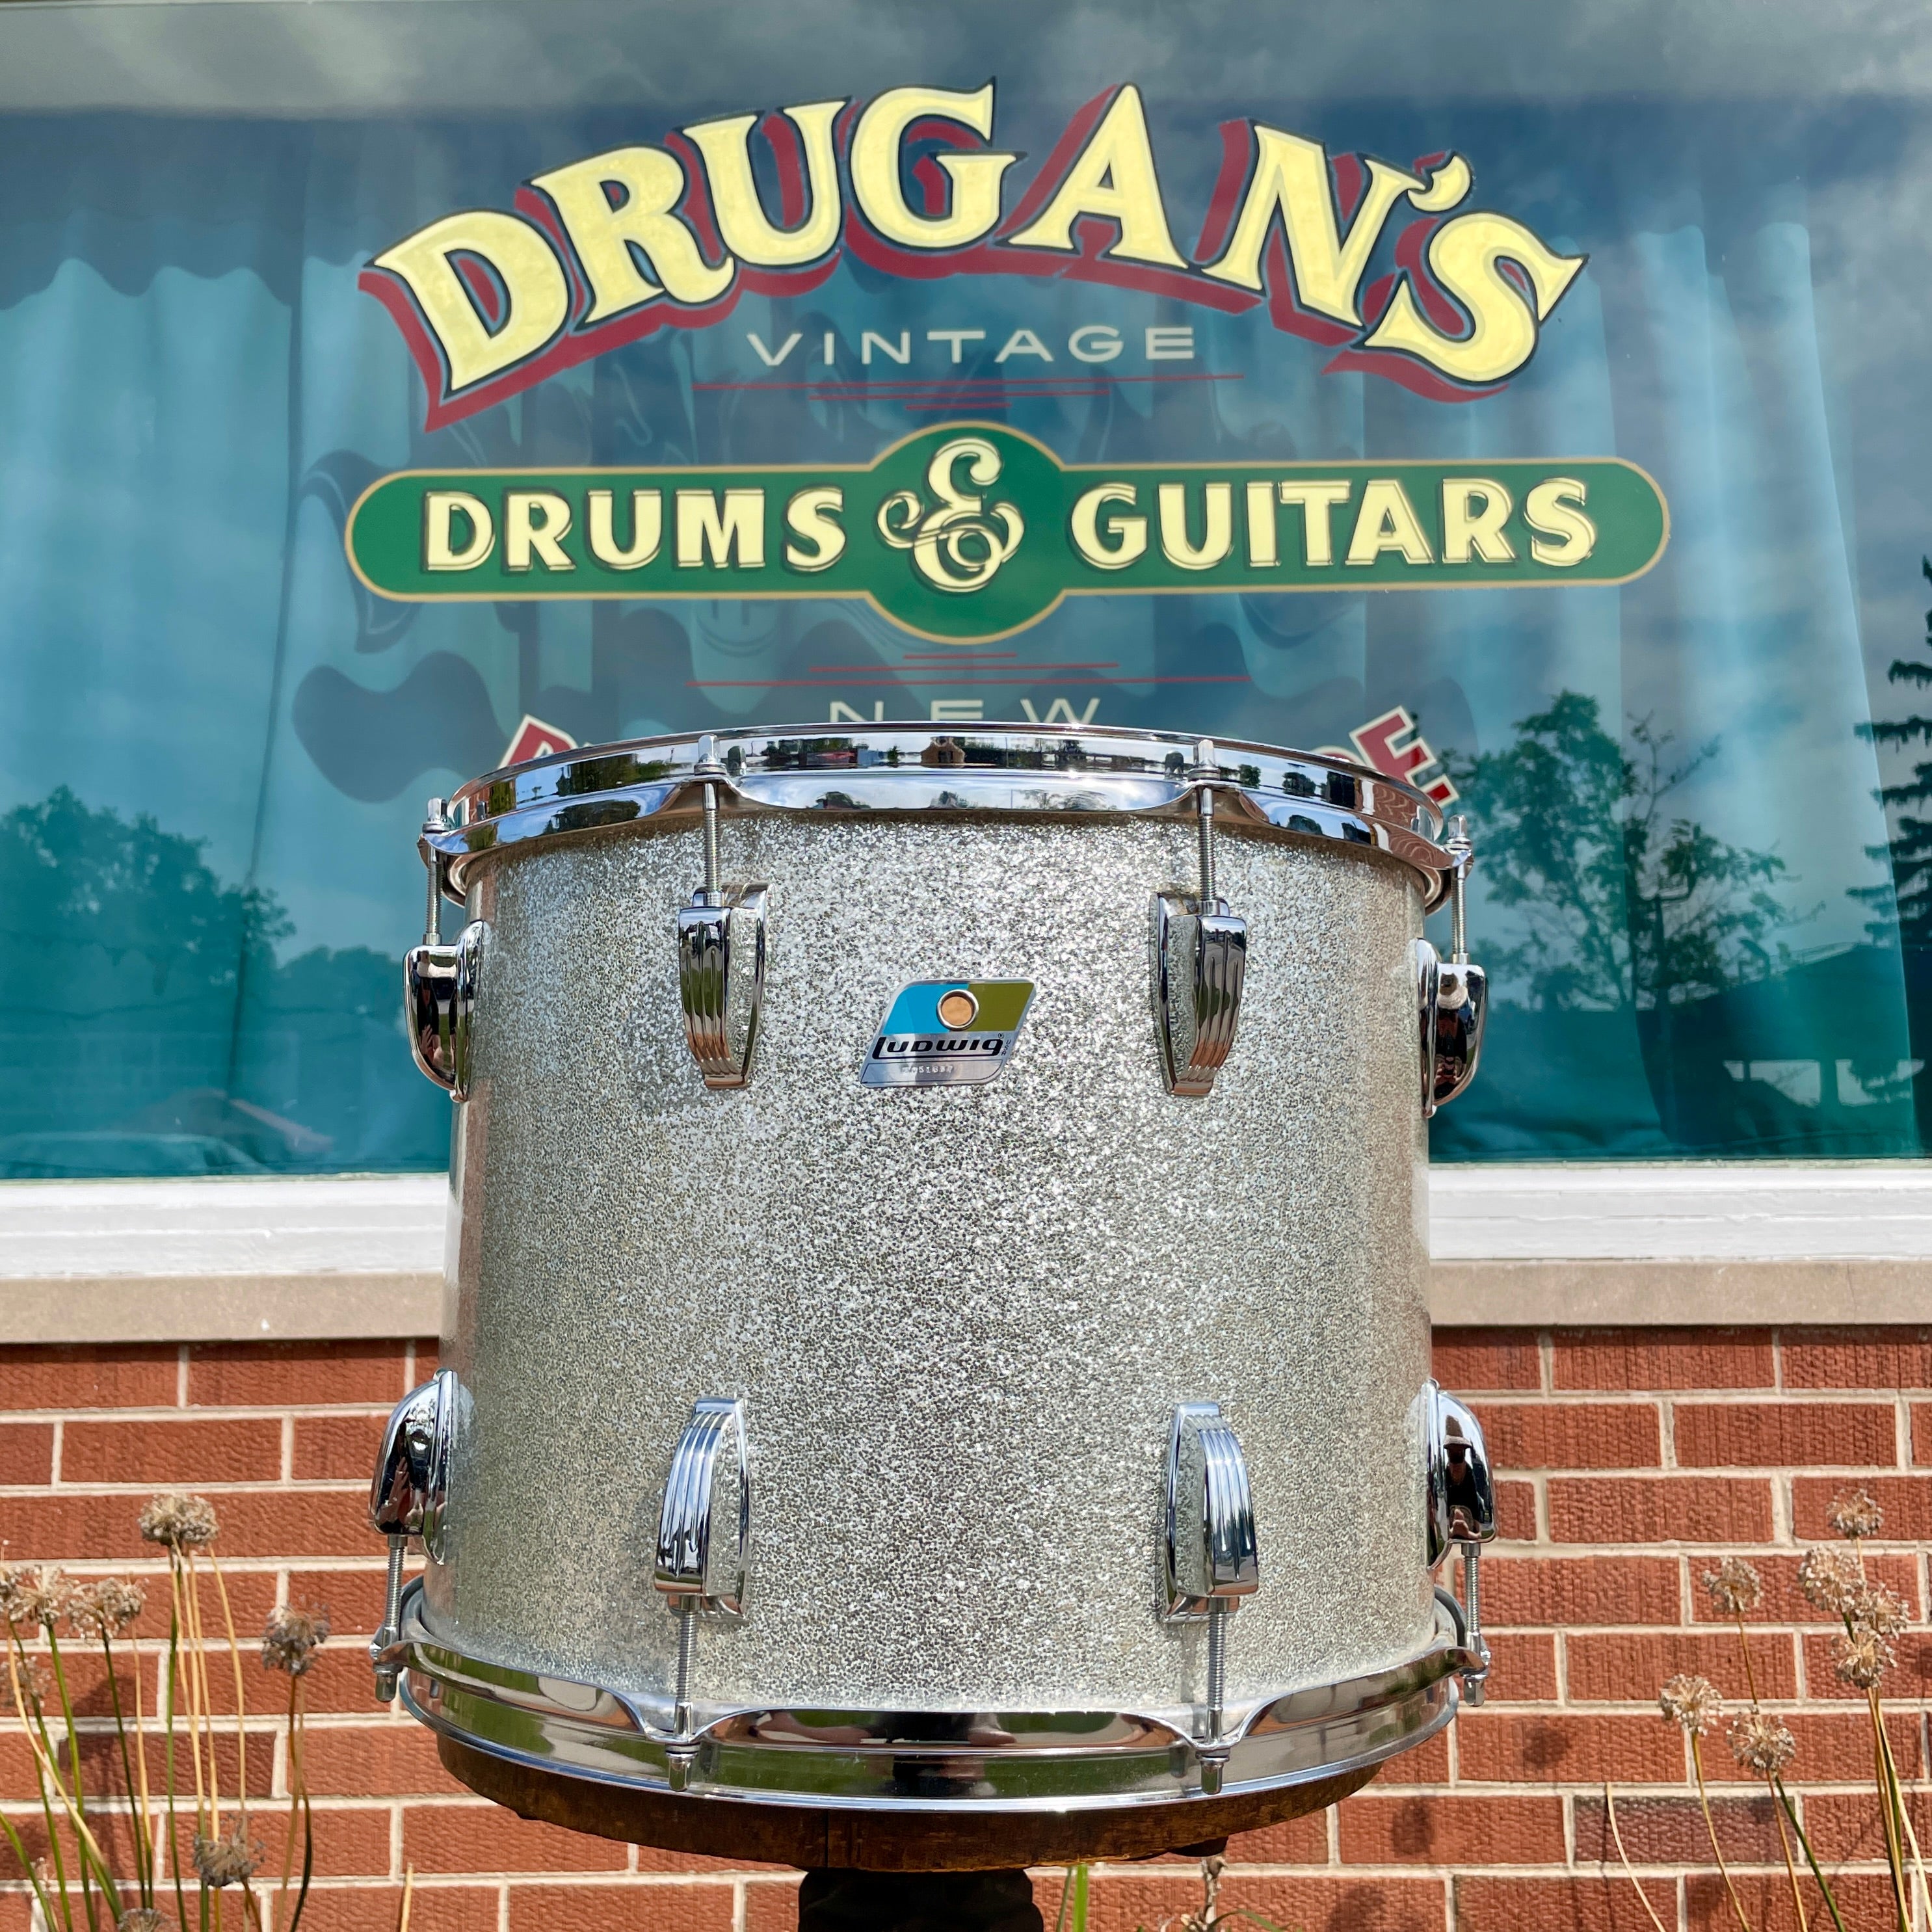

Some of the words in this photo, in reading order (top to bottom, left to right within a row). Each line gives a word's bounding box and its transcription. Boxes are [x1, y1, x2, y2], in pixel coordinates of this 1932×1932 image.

[364, 77, 1588, 401] DRUGAN'S
[747, 326, 1194, 365] VINTAGE
[424, 488, 845, 572] DRUMS
[877, 438, 1025, 593] &
[1071, 477, 1597, 570] GUITARS
